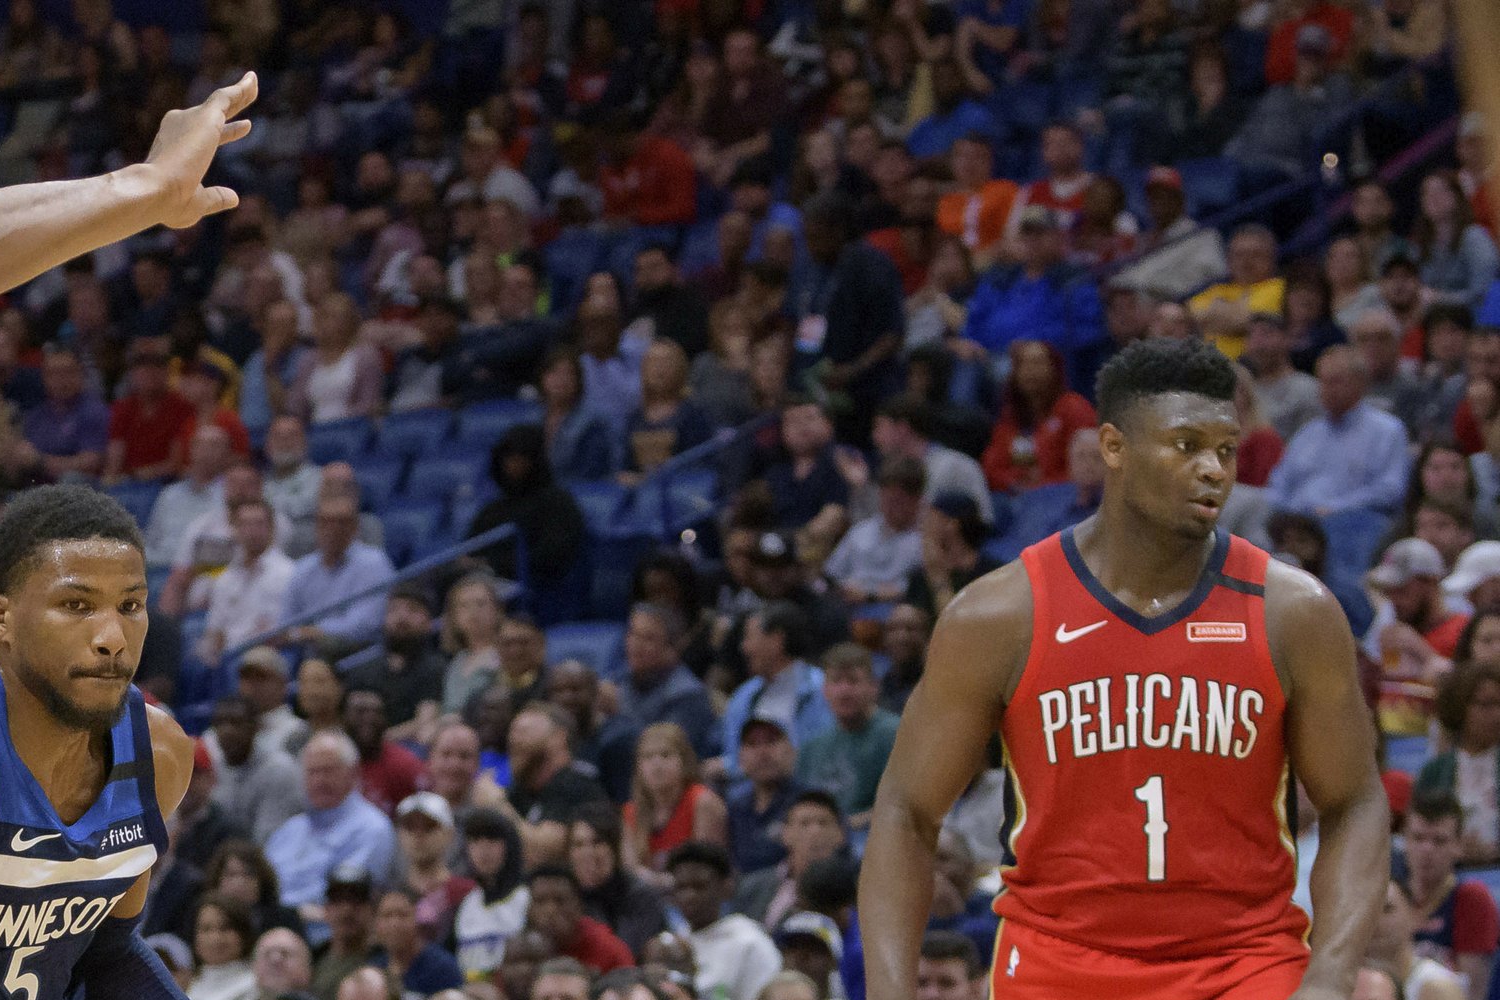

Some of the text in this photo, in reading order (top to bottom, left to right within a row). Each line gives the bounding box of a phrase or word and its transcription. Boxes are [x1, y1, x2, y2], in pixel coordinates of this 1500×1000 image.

[1039, 672, 1265, 764] PELICANS
[109, 823, 144, 847] fitbit
[1134, 775, 1169, 881] 1
